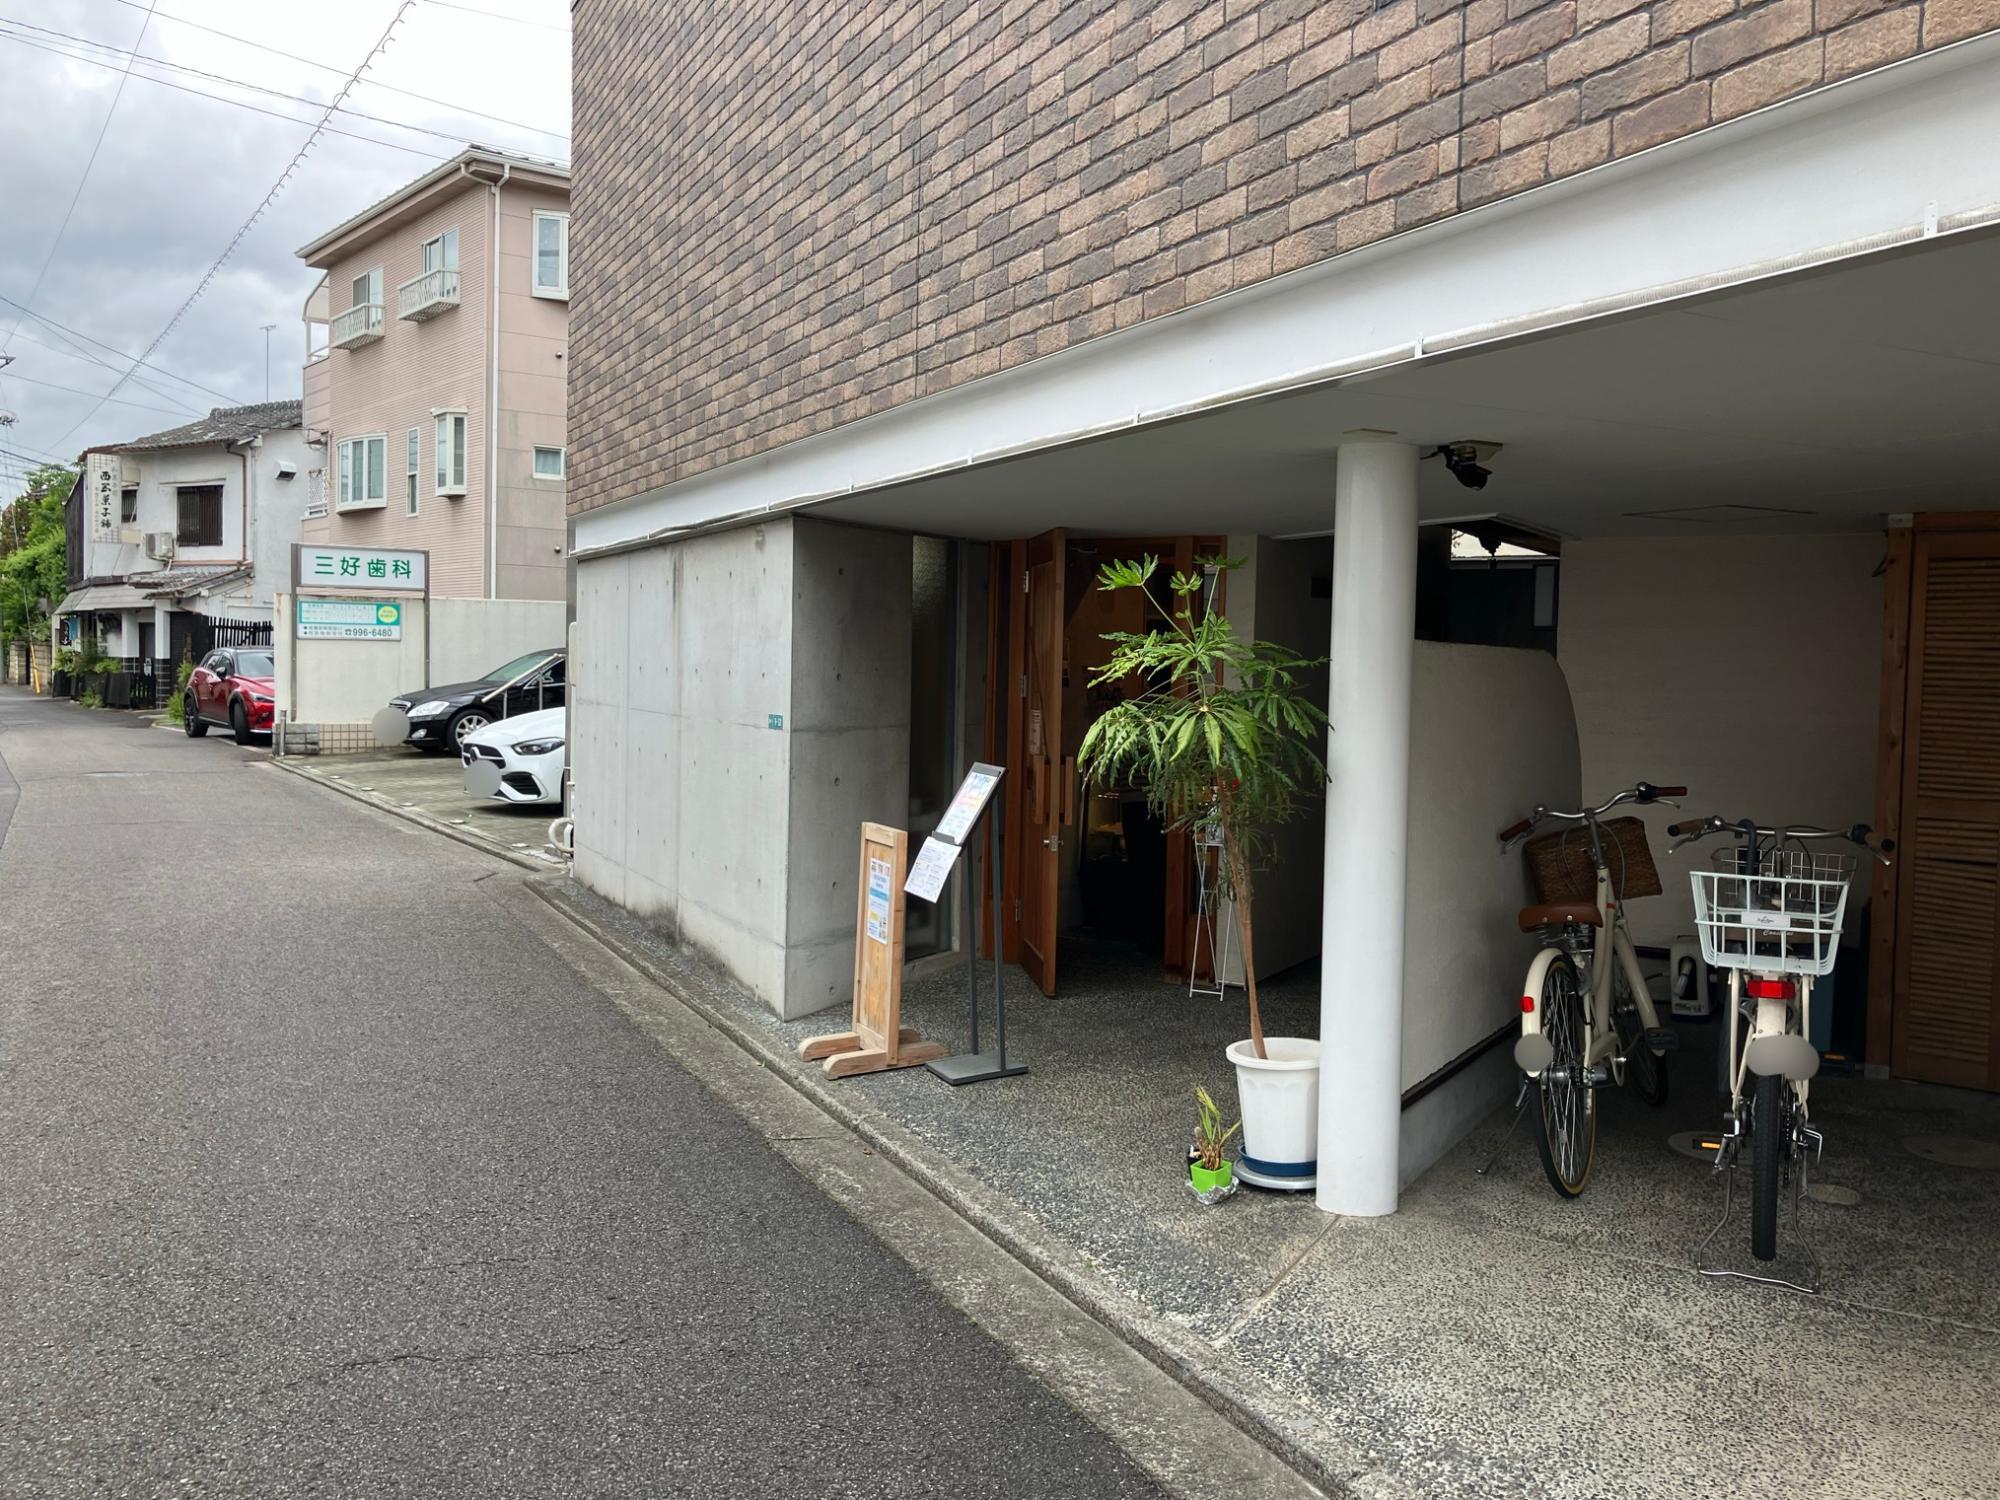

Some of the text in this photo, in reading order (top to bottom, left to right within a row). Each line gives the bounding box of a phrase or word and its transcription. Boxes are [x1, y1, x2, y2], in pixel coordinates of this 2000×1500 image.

[314, 556, 412, 579] 三好歯科
[352, 628, 393, 637] 996-6480
